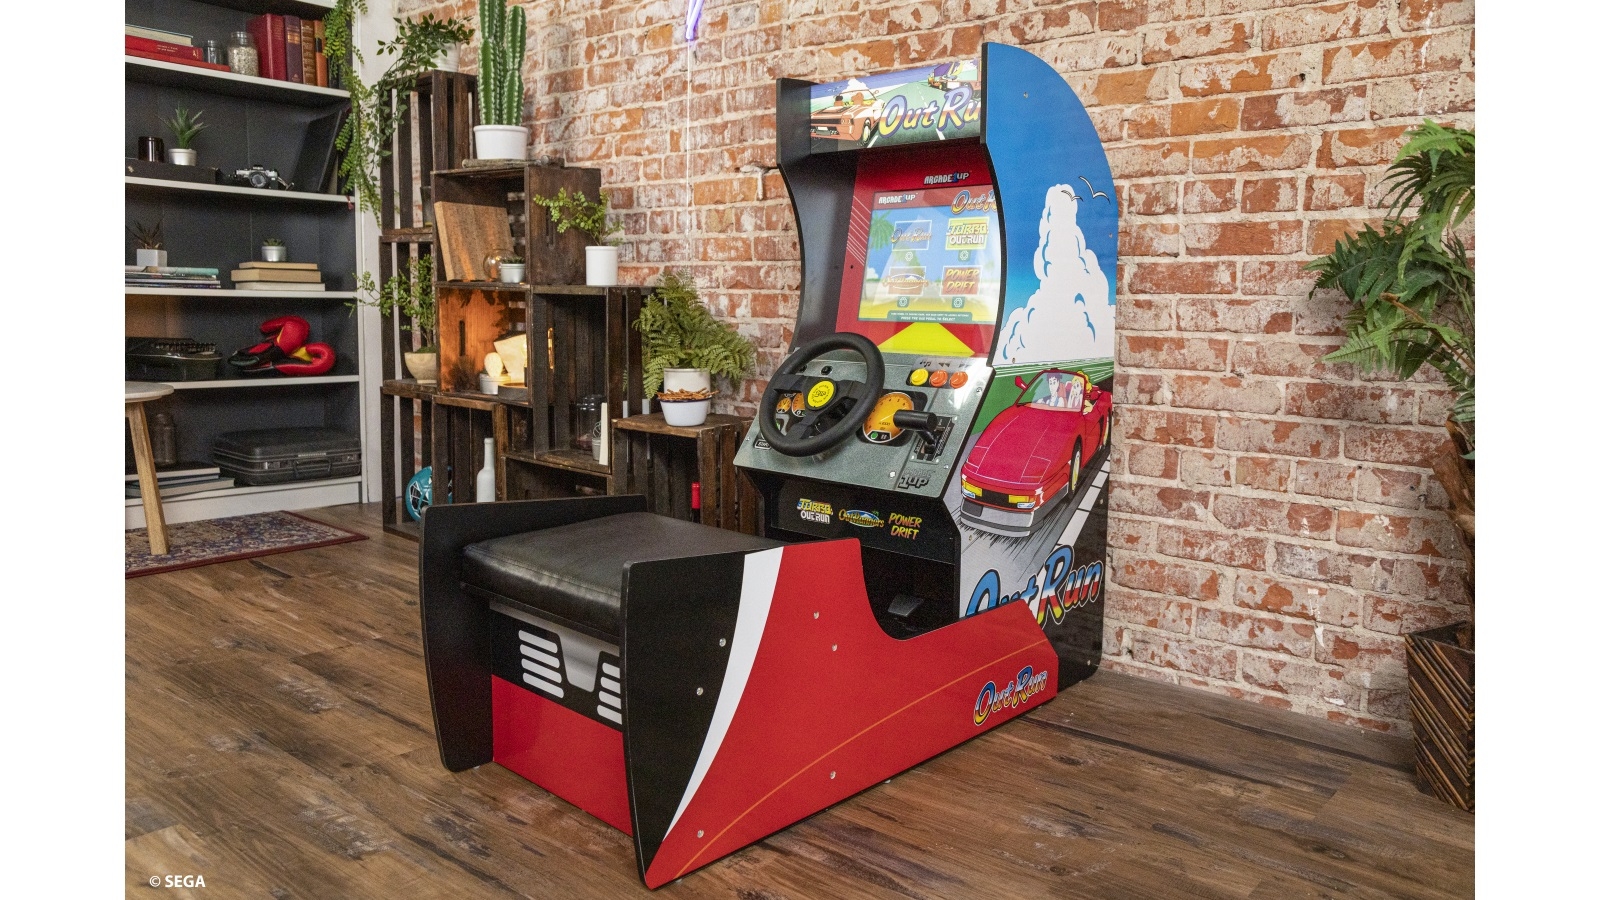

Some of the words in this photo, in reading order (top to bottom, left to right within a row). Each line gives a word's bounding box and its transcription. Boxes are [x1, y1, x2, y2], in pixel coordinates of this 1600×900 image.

[879, 95, 940, 138] Out
[937, 86, 981, 131] Ru
[946, 268, 980, 279] POWER
[946, 281, 975, 291] DRIFT
[888, 512, 922, 528] POWER
[890, 525, 919, 540] DRIFT
[1037, 545, 1104, 629] Run
[973, 681, 1015, 726] Out
[1012, 665, 1048, 708] Run
